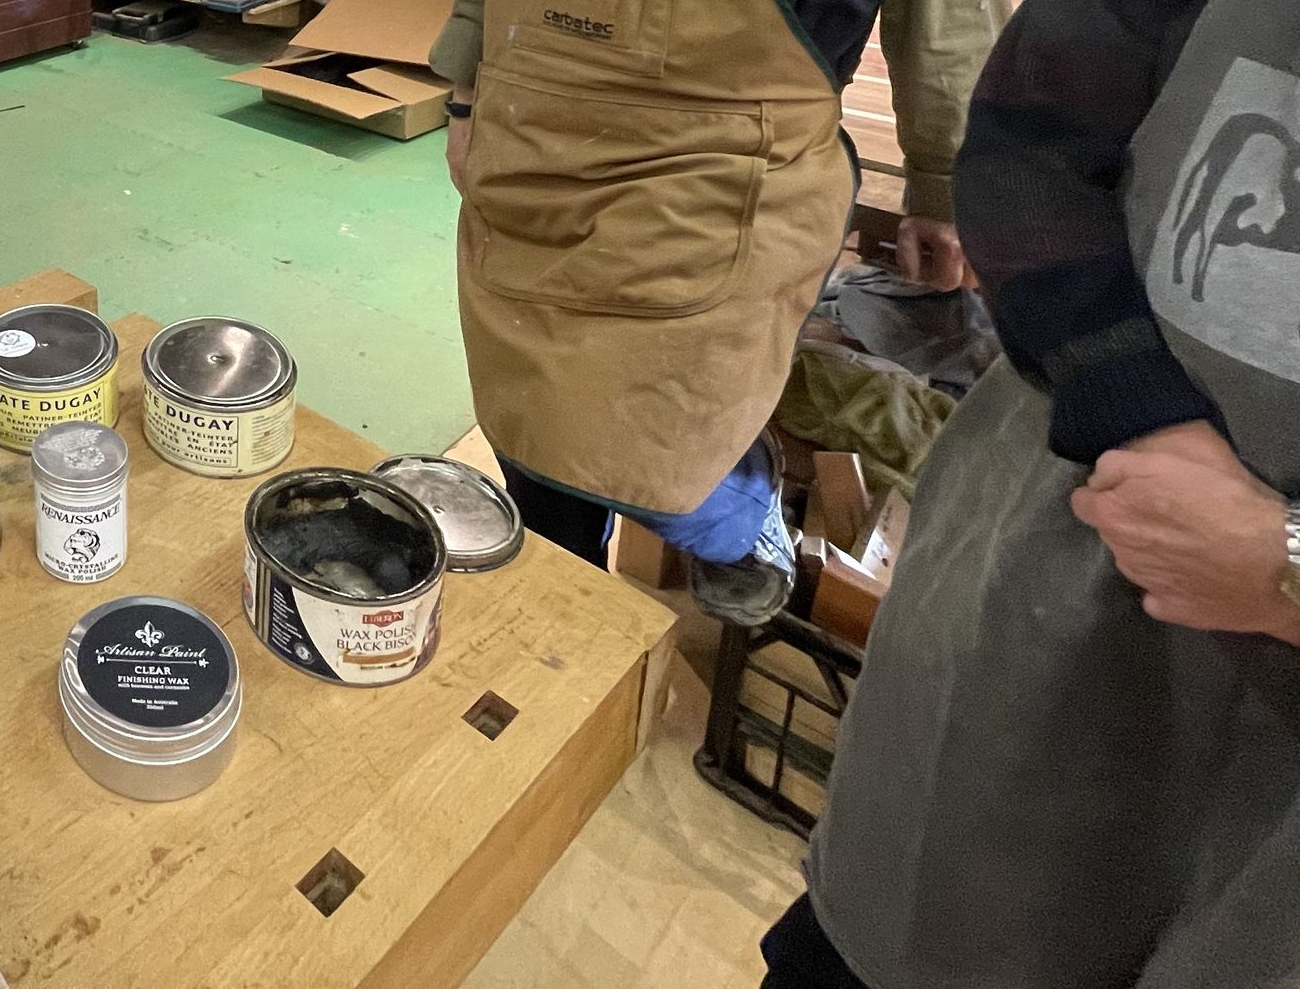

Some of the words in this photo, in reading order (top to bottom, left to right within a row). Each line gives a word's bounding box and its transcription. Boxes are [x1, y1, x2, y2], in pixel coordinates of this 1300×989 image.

[40, 387, 101, 412] DUGAY
[6, 417, 53, 429] REMETTR
[166, 405, 233, 430] DUGAY
[188, 444, 233, 455] ANCIENS
[41, 503, 120, 525] RENAISSANCE
[341, 628, 370, 640] WAX
[96, 644, 156, 657] Artisan
[159, 645, 206, 657] Paint
[337, 639, 380, 651] BLACK
[134, 666, 171, 675] CLEAR
[118, 676, 165, 684] FINISHING
